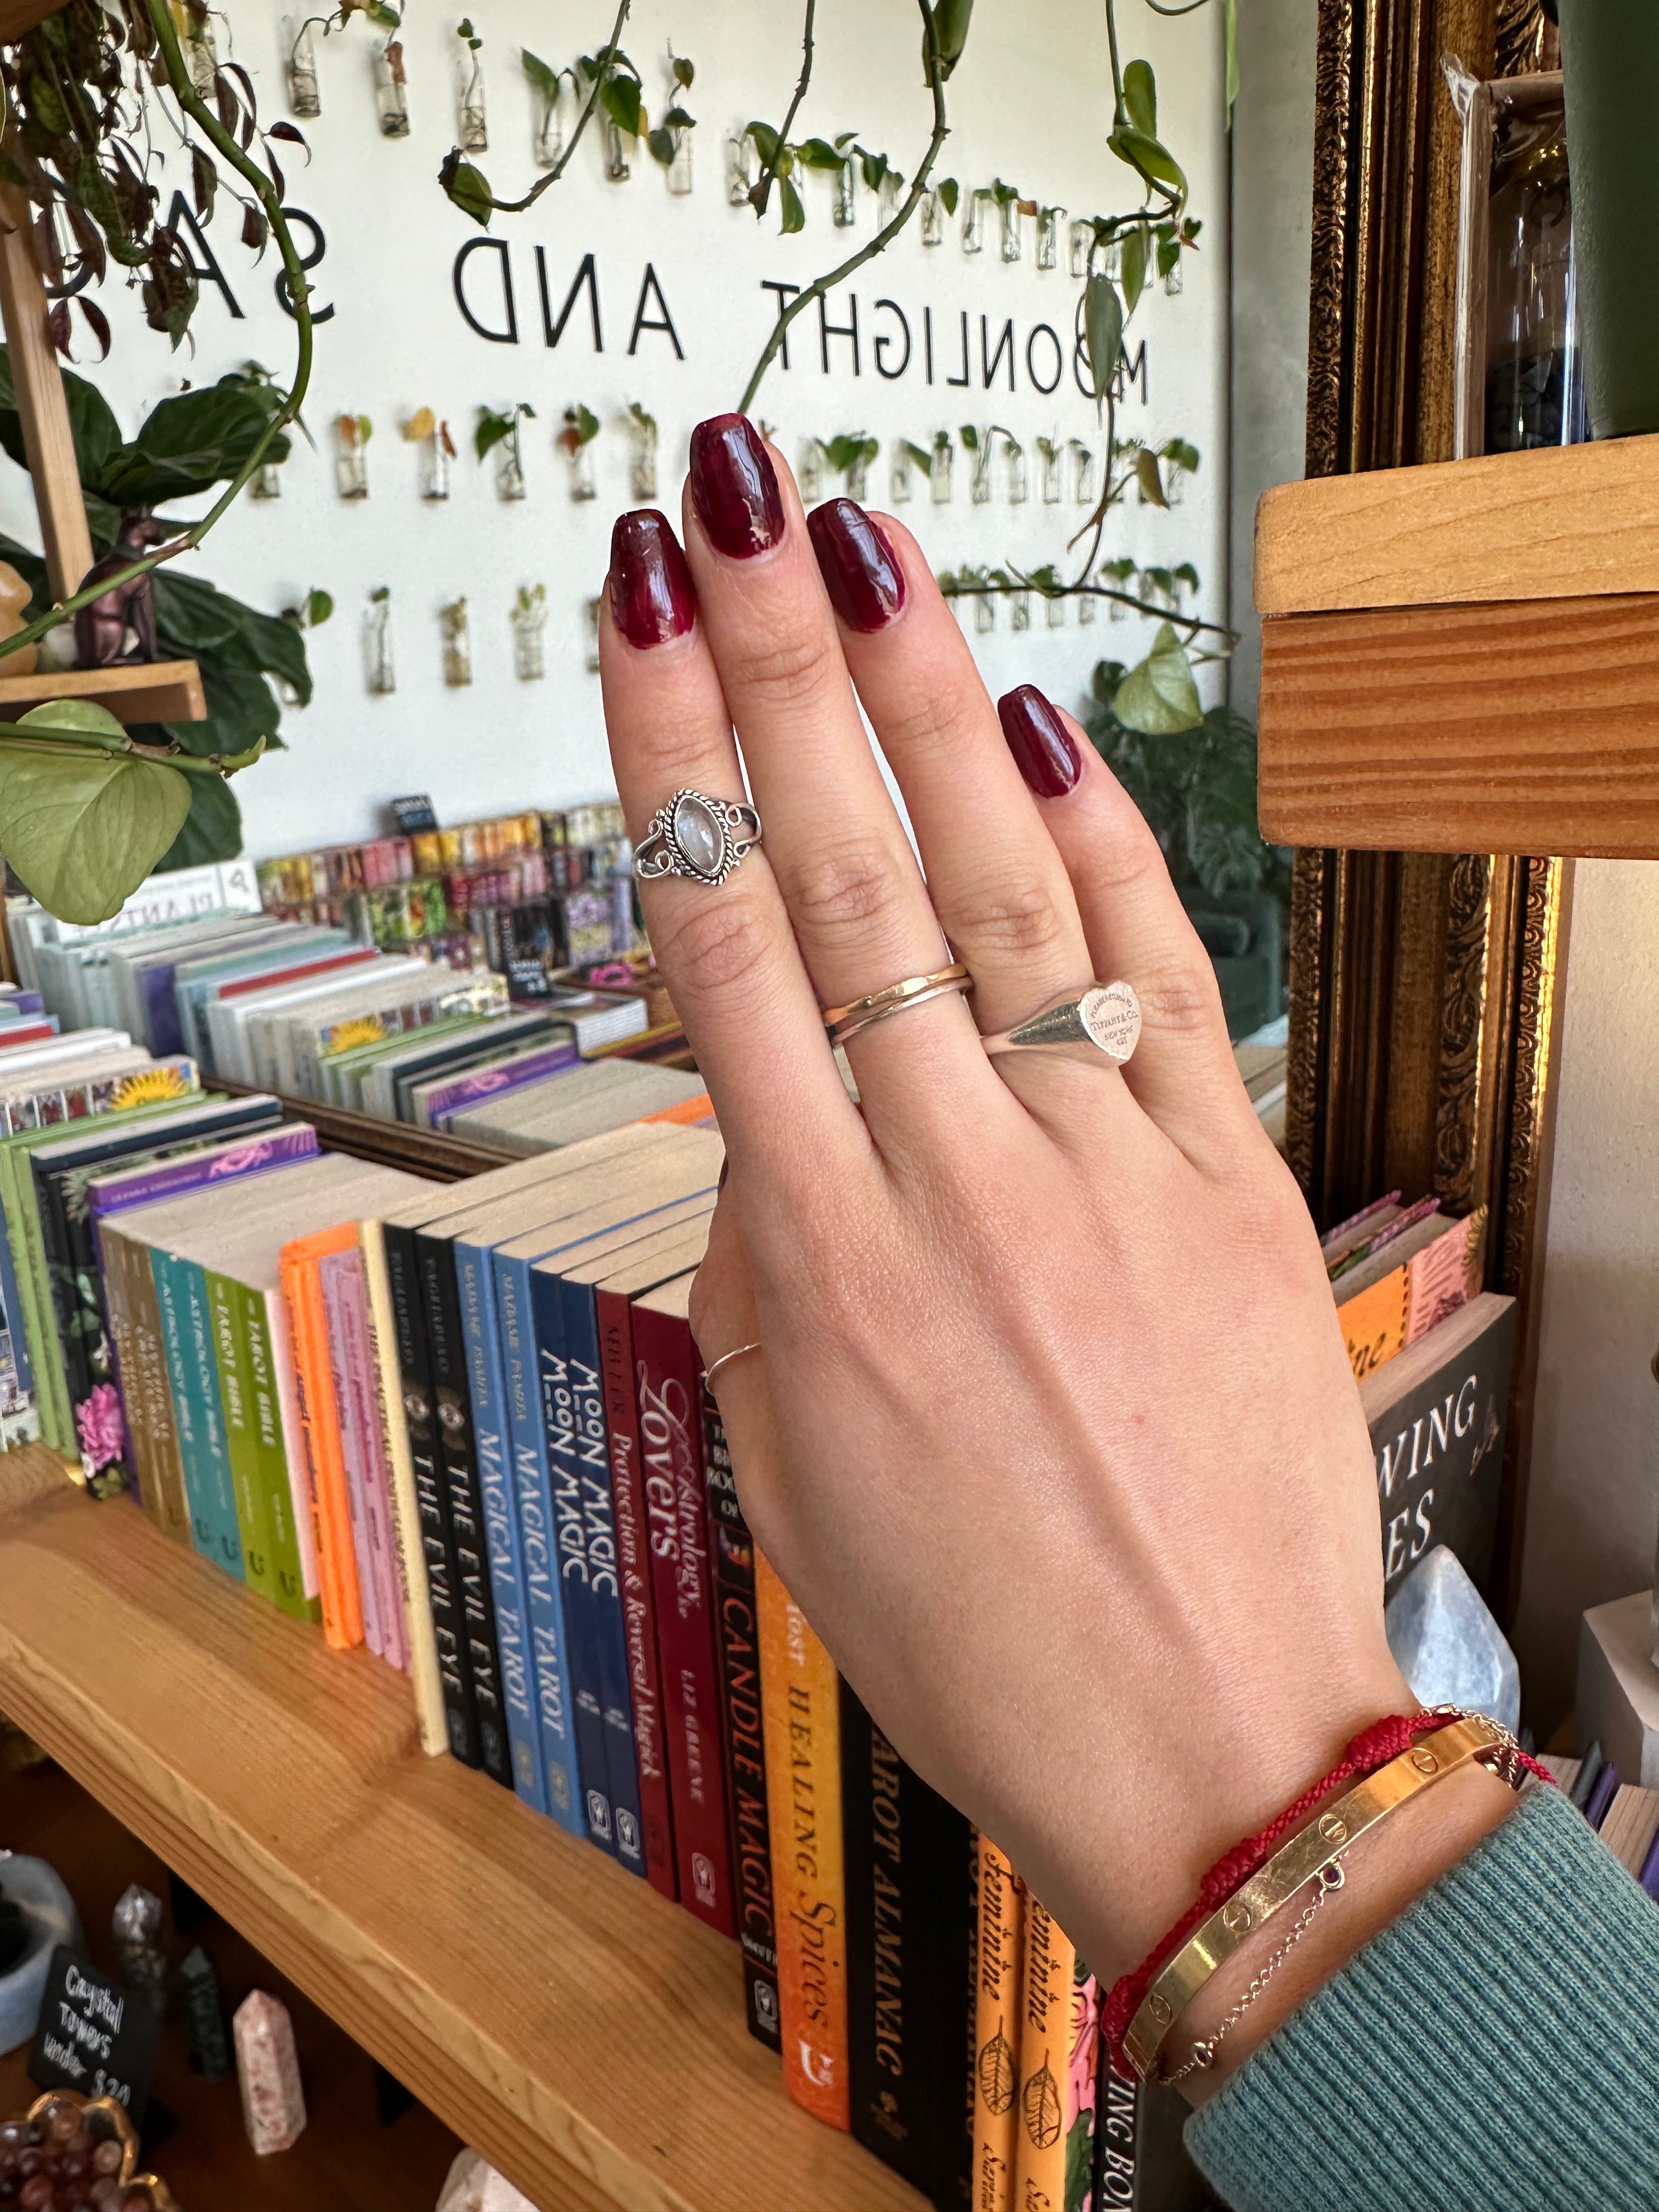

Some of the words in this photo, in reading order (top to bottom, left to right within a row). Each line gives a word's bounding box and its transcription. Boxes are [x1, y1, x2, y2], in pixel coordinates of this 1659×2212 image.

[540, 1348, 575, 1457] MOON
[570, 1358, 606, 1468] MOON
[636, 1359, 689, 1561] Lovers
[414, 1455, 441, 1524] THE
[447, 1465, 475, 1536] THE
[551, 1465, 588, 1583] MAGIC
[581, 1476, 618, 1597] MAGIC
[425, 1536, 451, 1607] EVIL
[458, 1547, 486, 1622] EVIL
[475, 1427, 515, 1583] MAGICAL
[496, 1607, 530, 1719] TAROT
[515, 1443, 552, 1603] MAGICAL
[534, 1626, 565, 1740] TAROT
[624, 1570, 643, 1591] &
[436, 1626, 462, 1694] EYE
[469, 1638, 497, 1707] EYE
[723, 1596, 763, 1781] CANDLE
[787, 1683, 820, 1881] HEALING
[738, 1788, 773, 1937] MAGIC
[789, 1890, 840, 2030] Spices
[873, 1866, 903, 2075] ALMANAC
[981, 1853, 1023, 2001] Feminine
